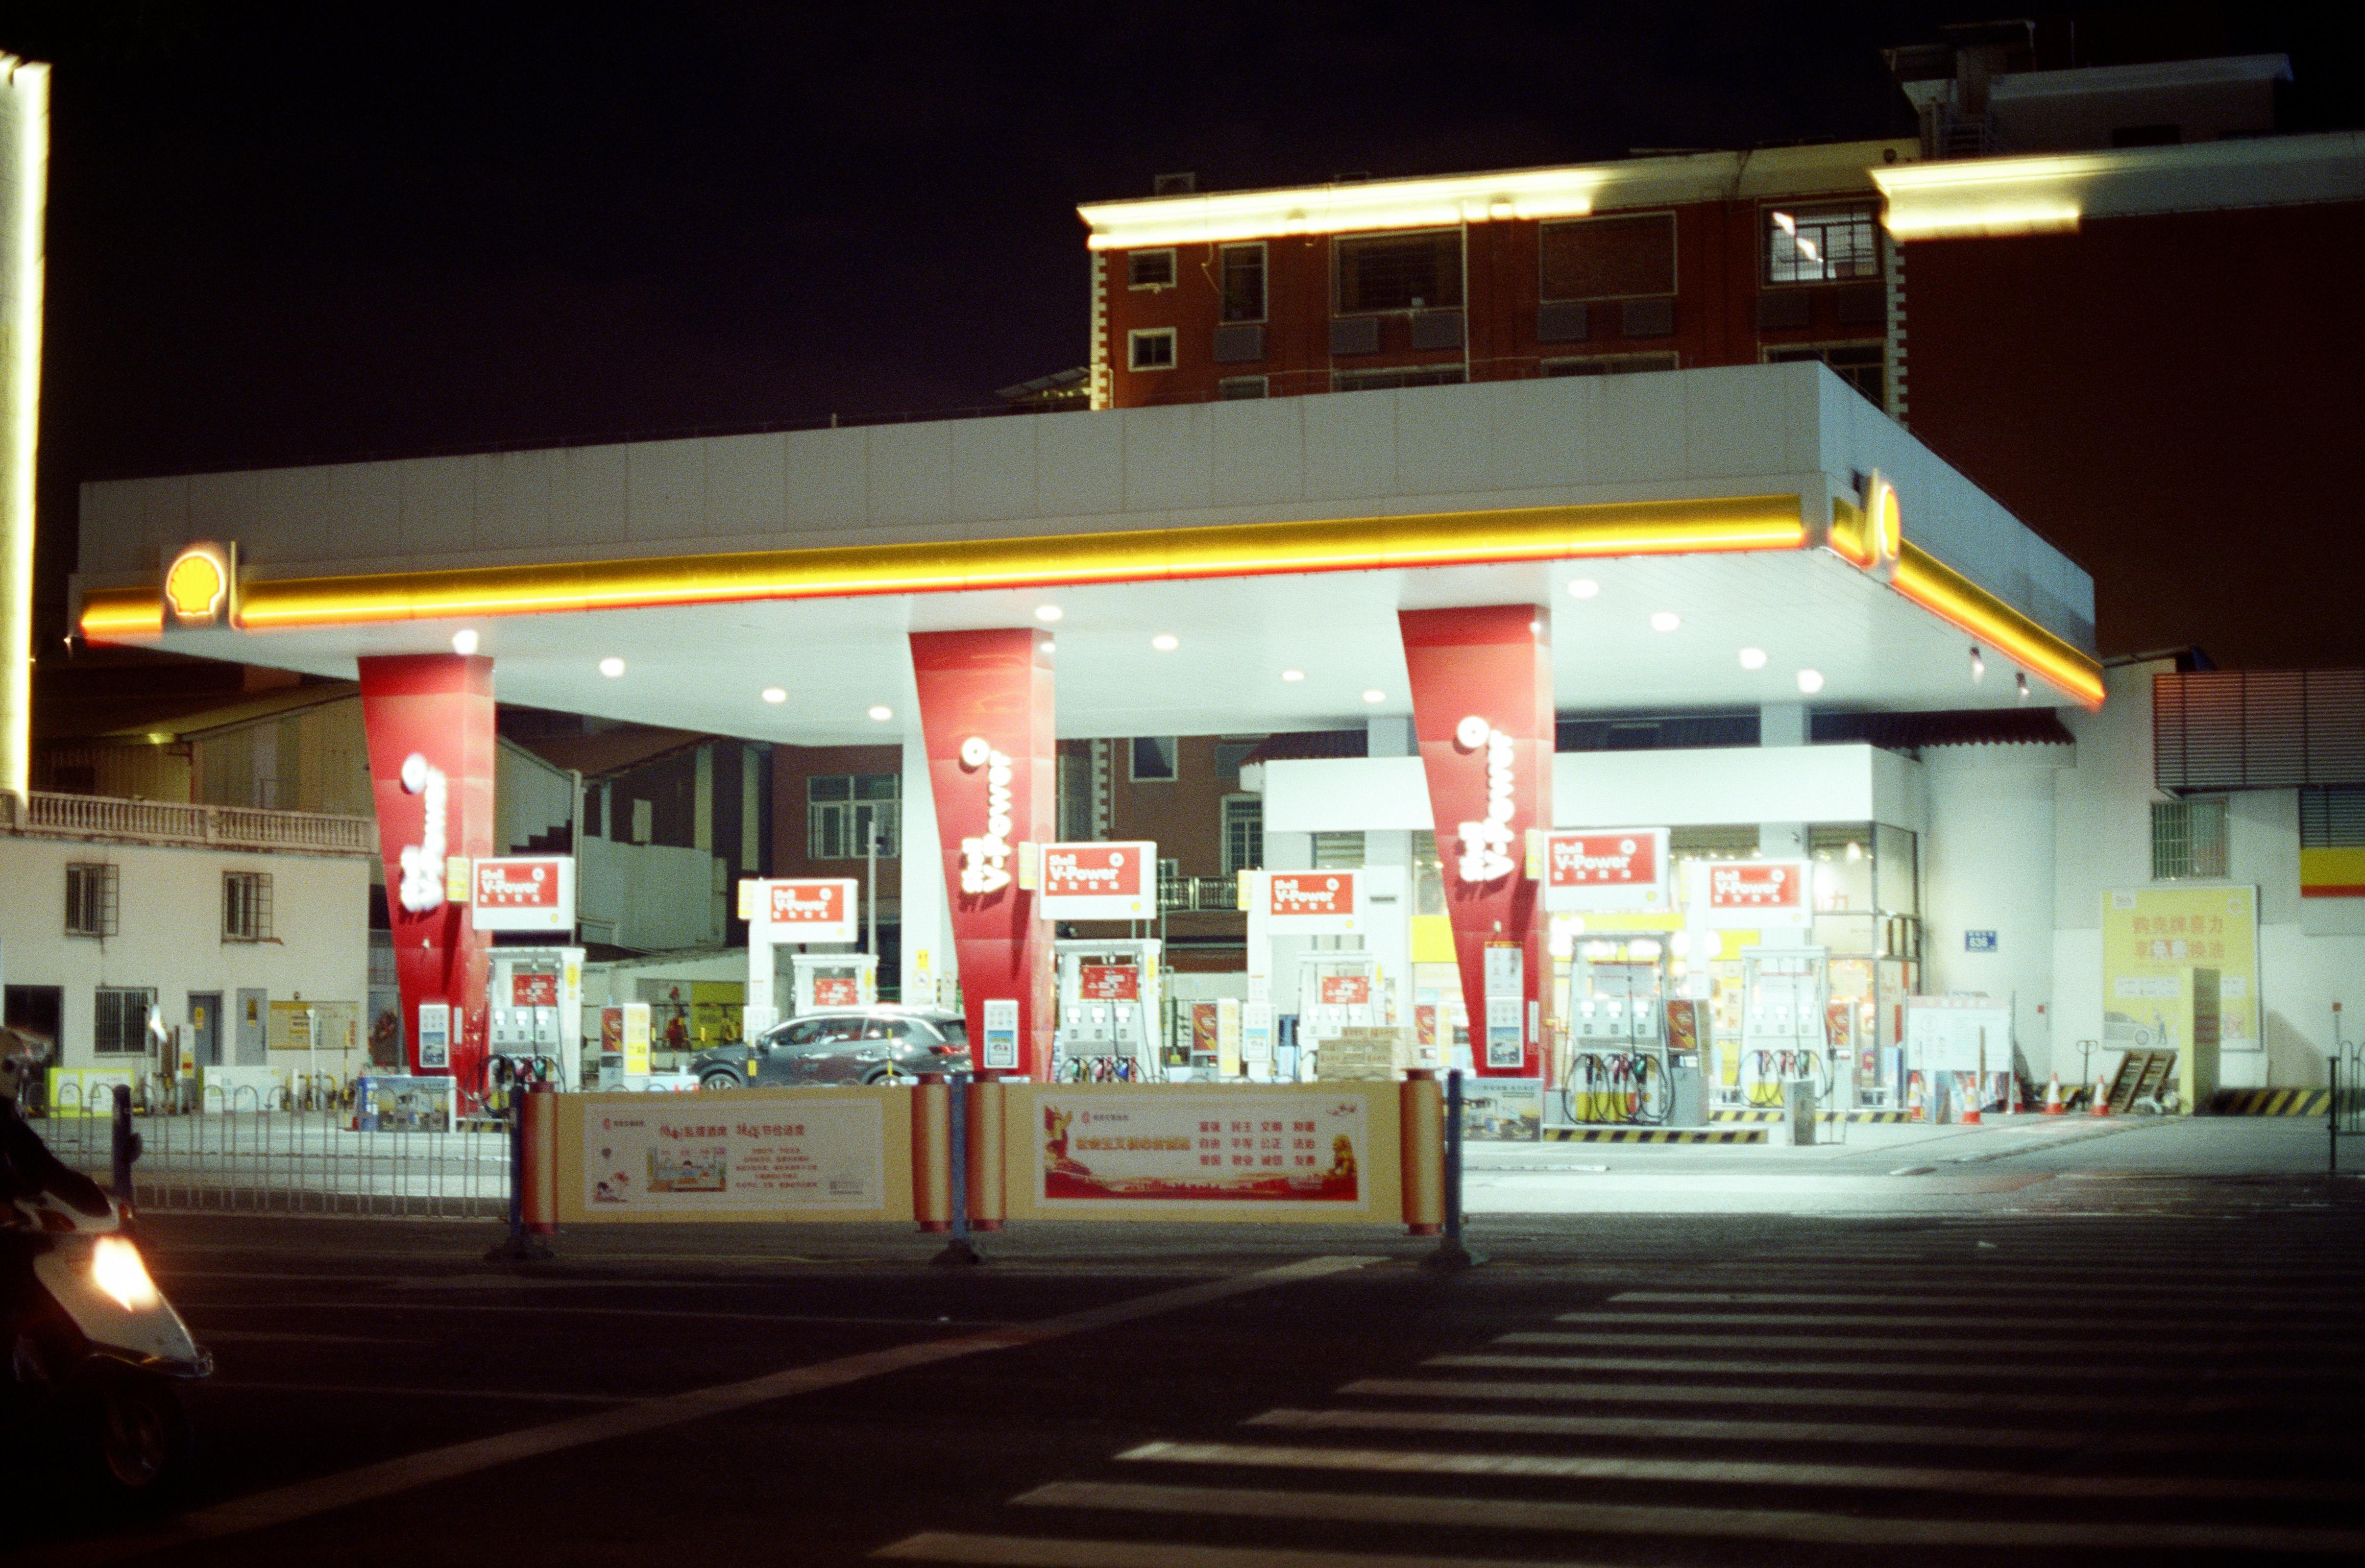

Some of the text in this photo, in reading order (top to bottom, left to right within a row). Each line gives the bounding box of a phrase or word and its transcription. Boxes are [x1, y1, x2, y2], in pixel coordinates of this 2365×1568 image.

[1554, 854, 1631, 870] V-Power
[1049, 866, 1119, 880] V-Power
[1199, 1138, 1220, 1149] 自由
[1261, 1138, 1281, 1149] 公正
